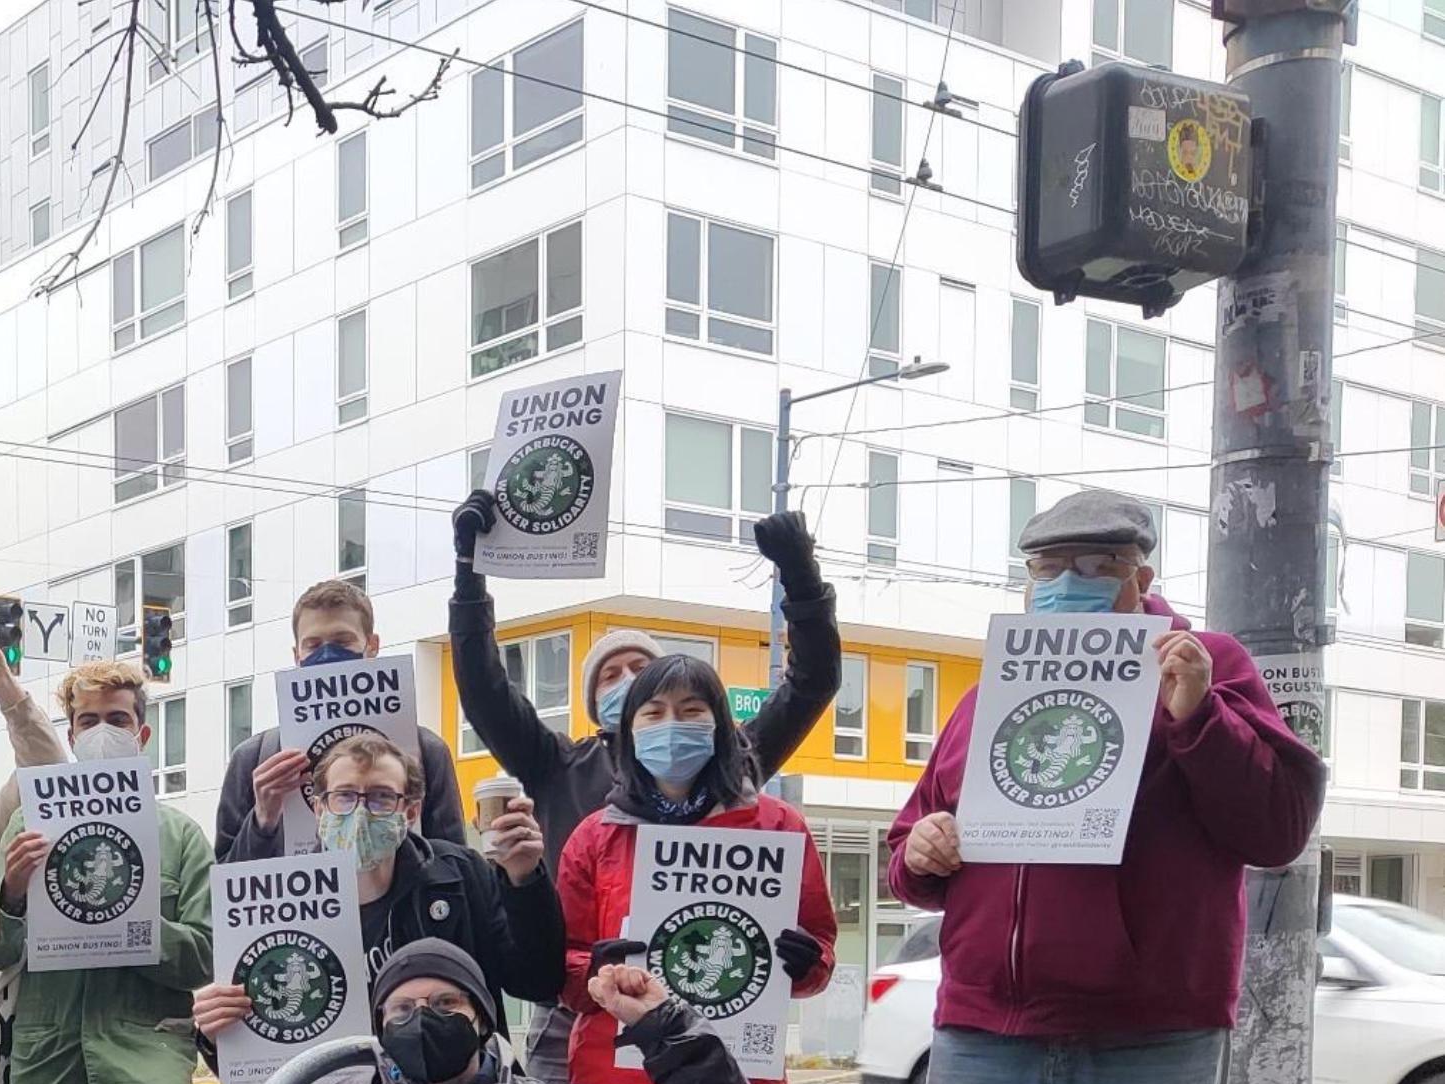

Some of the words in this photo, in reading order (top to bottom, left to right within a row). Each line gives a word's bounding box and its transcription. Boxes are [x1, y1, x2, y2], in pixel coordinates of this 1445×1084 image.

[511, 383, 607, 418] UNION
[507, 408, 603, 437] STRONG
[511, 436, 584, 465] STARBUCKS
[497, 479, 529, 531] WORKER
[532, 475, 592, 532] SOLIDARITY
[85, 608, 105, 622] NO
[83, 624, 108, 638] TURN
[87, 640, 101, 651] ON
[1005, 628, 1147, 656] UNION
[291, 668, 399, 702] UNION
[1000, 660, 1141, 682] STRONG
[293, 696, 401, 723] STRONG
[735, 694, 761, 712] BRO
[1011, 693, 1113, 725] STARBUCKS
[34, 770, 139, 800] UNION
[992, 742, 1029, 803] WORKER
[1032, 740, 1121, 807] SOLIDARITY
[39, 796, 141, 820] STRONG
[57, 824, 131, 854] STARBUCKS
[963, 830, 981, 838] NO
[982, 830, 1017, 838] UNION
[654, 841, 784, 874] UNION
[46, 868, 82, 920] WORKER
[86, 864, 141, 922] SOLIDARITY
[226, 867, 339, 902] UNION
[651, 871, 781, 898] STRONG
[227, 898, 341, 928] STRONG
[665, 904, 759, 939] STARBUCKS
[53, 942, 80, 951] UNION
[243, 934, 329, 967] STARBUCKS
[283, 975, 346, 1042] SOLIDARITY
